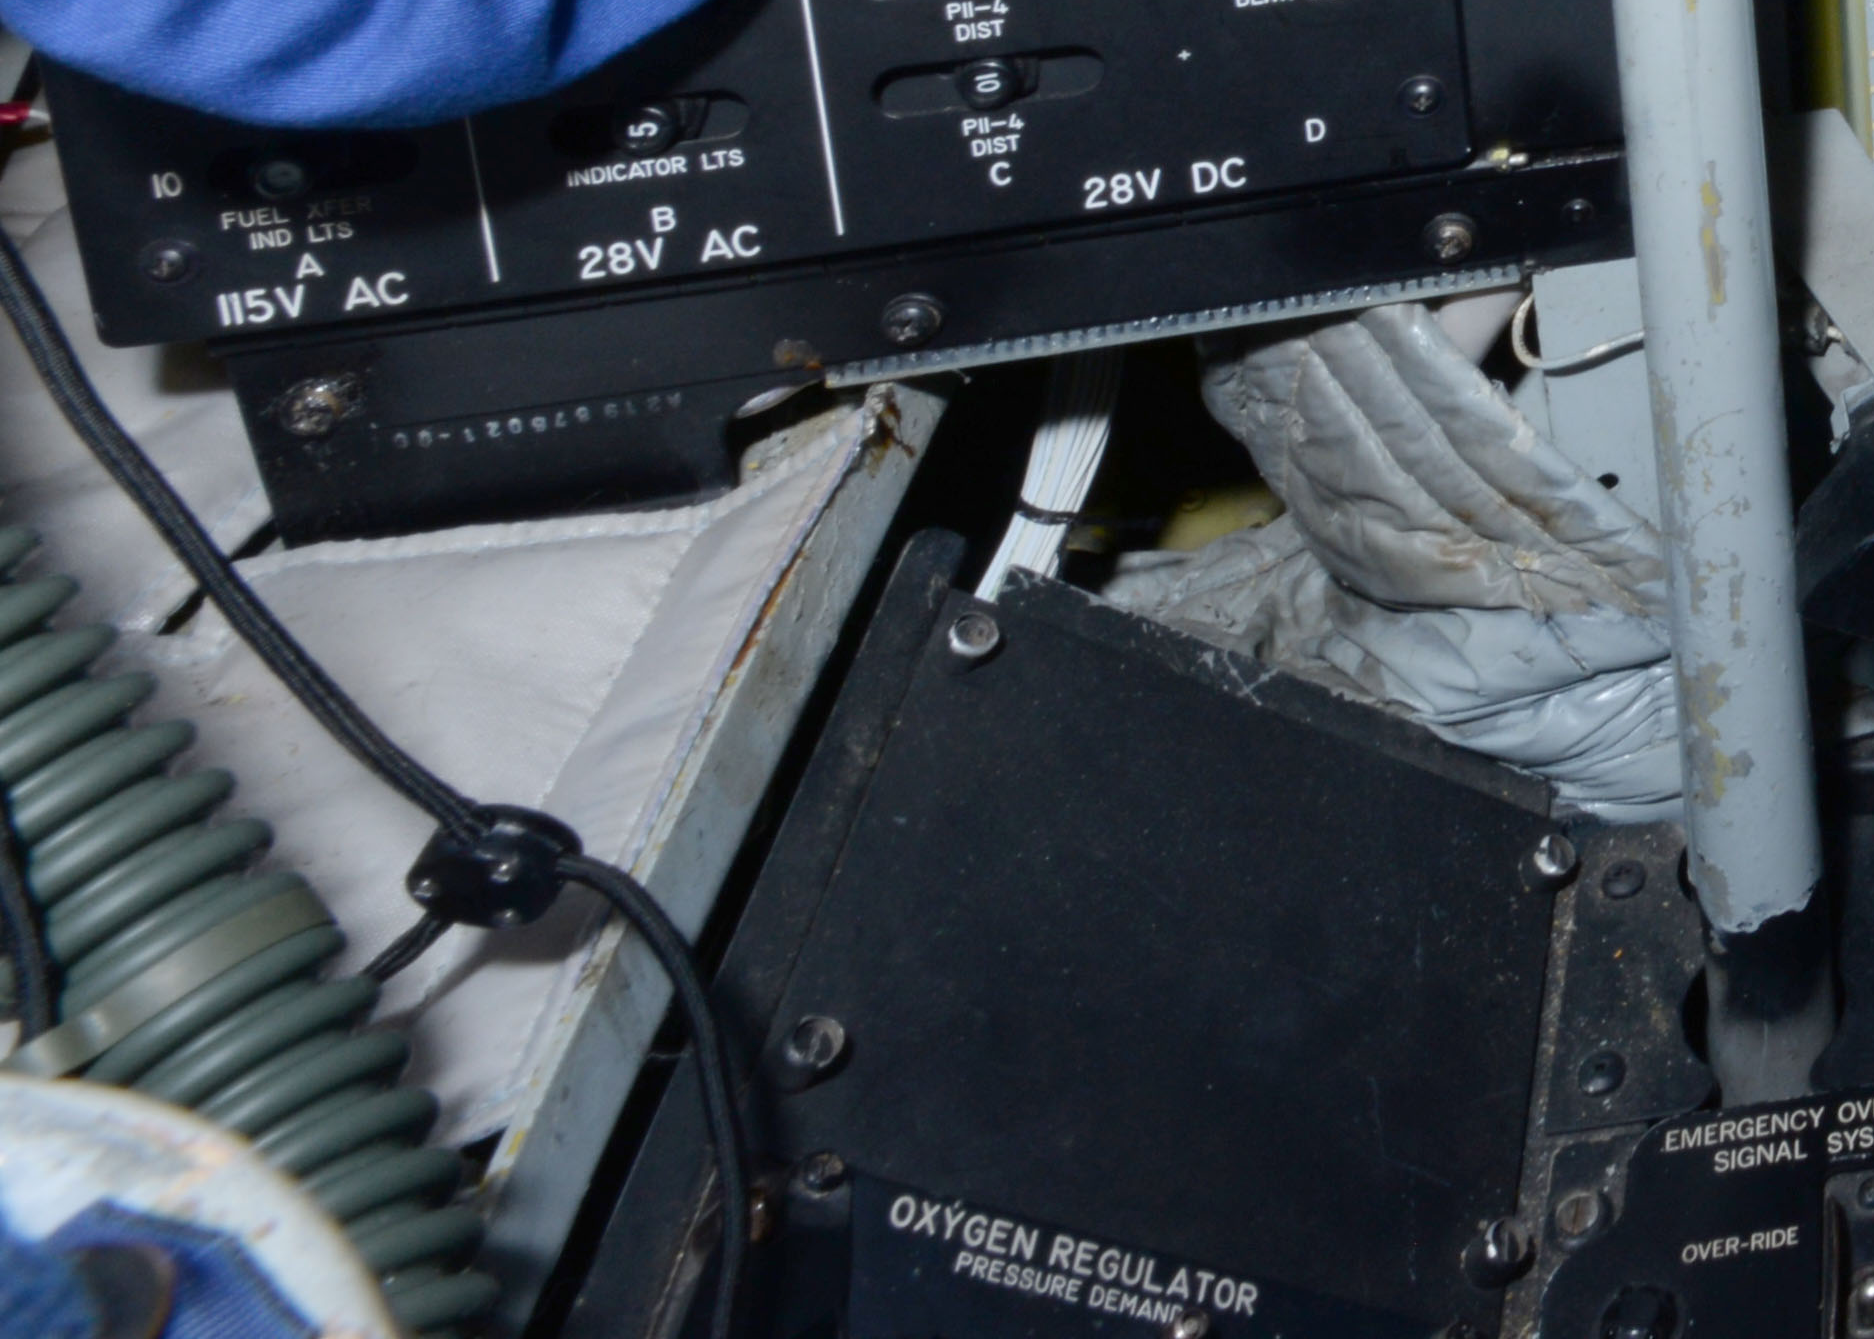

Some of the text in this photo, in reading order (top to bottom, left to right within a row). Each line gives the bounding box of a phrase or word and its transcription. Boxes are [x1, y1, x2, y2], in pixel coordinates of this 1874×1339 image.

[954, 20, 1005, 42] DIST
[971, 134, 1021, 158] DIST
[1305, 118, 1326, 143] D
[567, 147, 744, 189] INDICATOR LTS
[988, 161, 1012, 187] C
[1084, 157, 1247, 210] 28V DC
[151, 171, 184, 200] 10
[220, 207, 290, 231] FUEL
[652, 204, 677, 234] B
[250, 222, 355, 250] IND LTS
[295, 252, 326, 280] A
[578, 225, 762, 281] 28V AC
[216, 272, 409, 328] 115V AC
[1664, 1106, 1825, 1153] EMERGENCY
[1713, 1139, 1807, 1174] SIGNAL
[890, 1194, 1258, 1316] OXYGEN REGULATOR
[1682, 1226, 1799, 1264] OVER-RIDE
[954, 1251, 1079, 1303] PRESSURE
